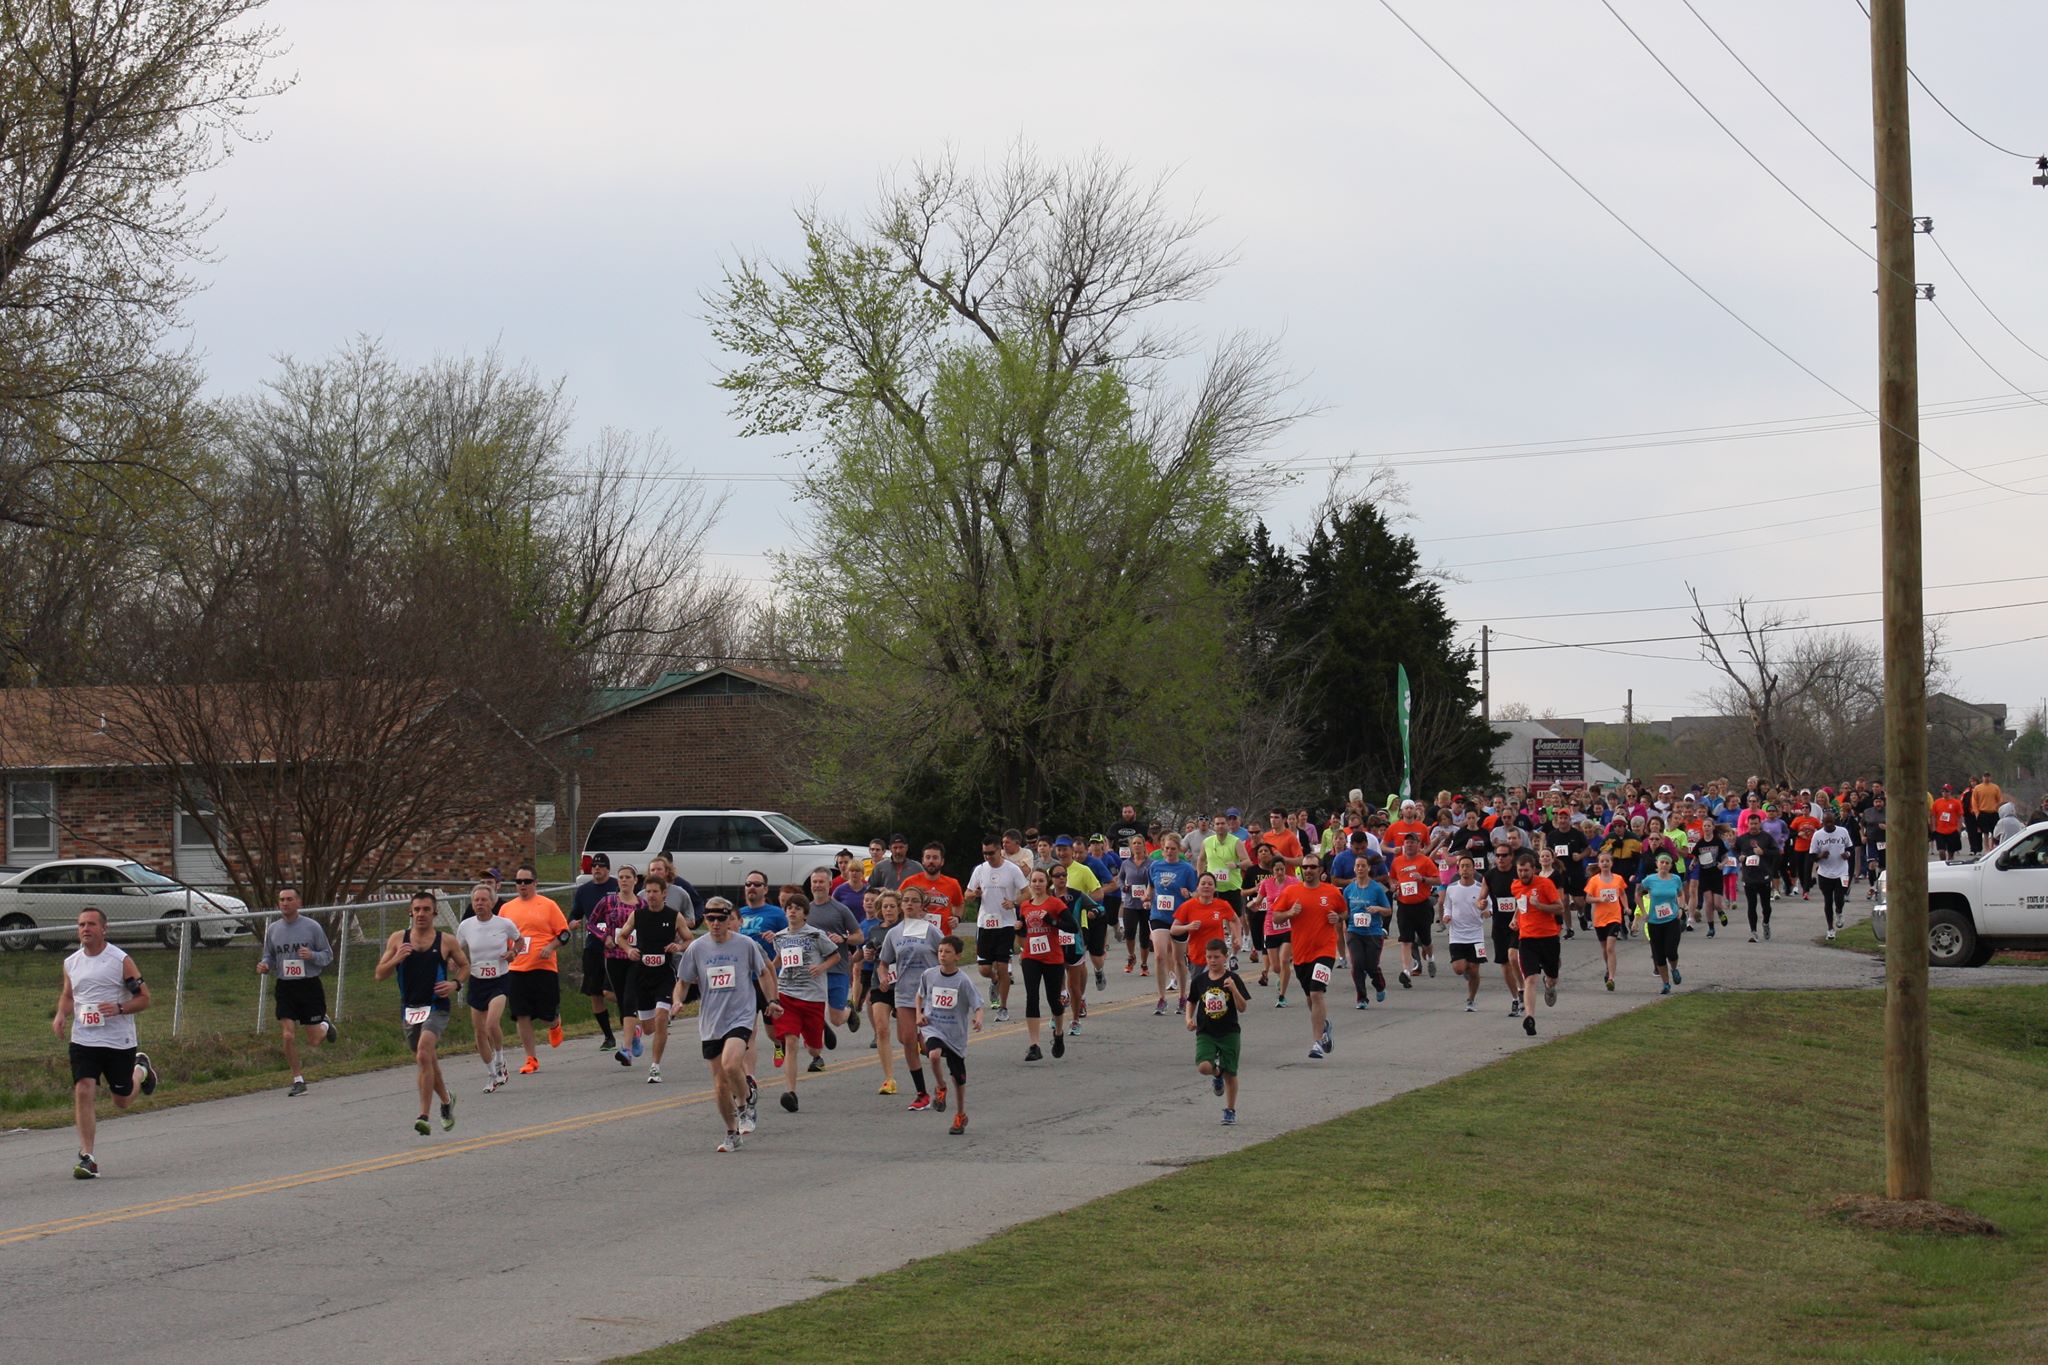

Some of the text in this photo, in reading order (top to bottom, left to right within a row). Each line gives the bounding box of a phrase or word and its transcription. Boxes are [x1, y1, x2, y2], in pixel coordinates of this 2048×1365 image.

[1158, 900, 1172, 909] 760
[985, 919, 1000, 927] 831
[1355, 917, 1368, 926] 781
[276, 943, 309, 954] ARMY
[1032, 942, 1047, 952] 810
[645, 955, 662, 965] 930
[782, 954, 799, 966] 919
[285, 966, 302, 976] 780
[480, 967, 497, 976] 753
[1314, 969, 1329, 982] 820
[711, 973, 732, 986] 737
[935, 995, 954, 1007] 782
[82, 1012, 101, 1025] 756
[409, 1011, 427, 1023] 772
